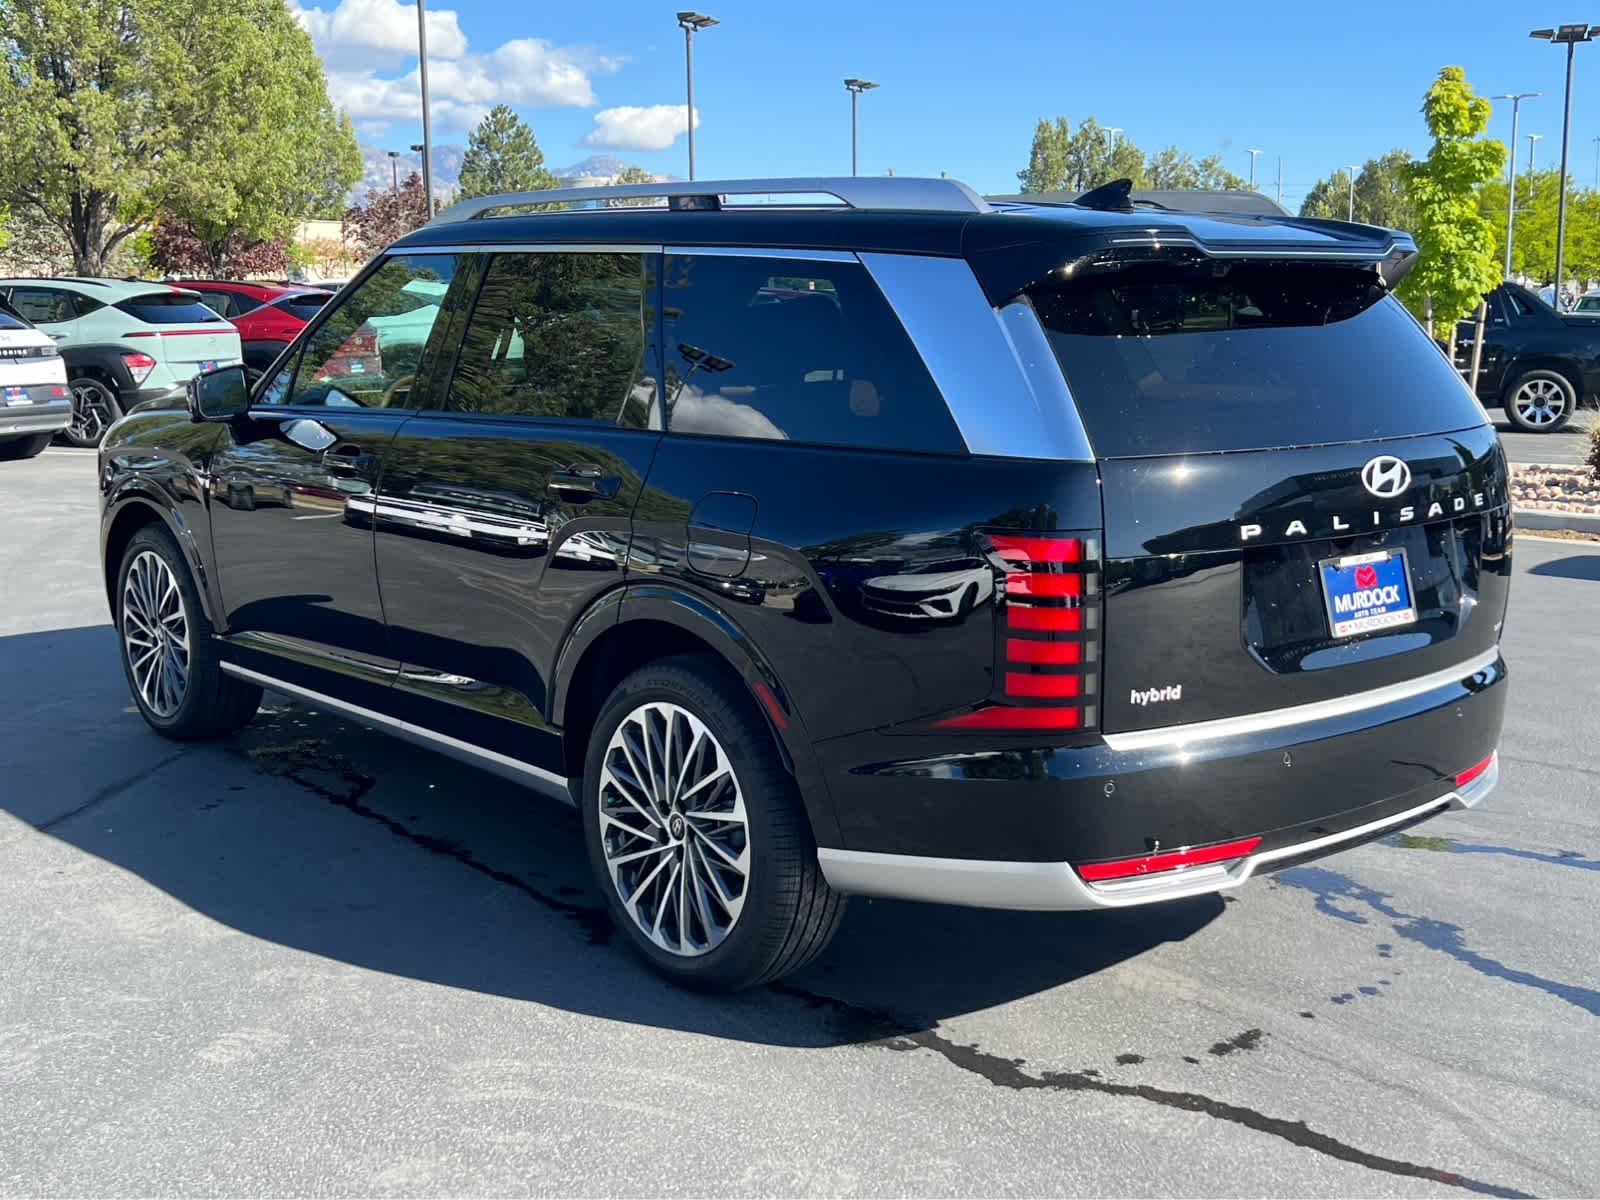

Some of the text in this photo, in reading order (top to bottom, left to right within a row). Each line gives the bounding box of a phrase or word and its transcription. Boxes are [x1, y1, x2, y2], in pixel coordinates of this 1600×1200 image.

[1240, 492, 1484, 540] PALISADE
[1334, 584, 1400, 613] MURDOCK
[1130, 684, 1182, 706] hybrid
